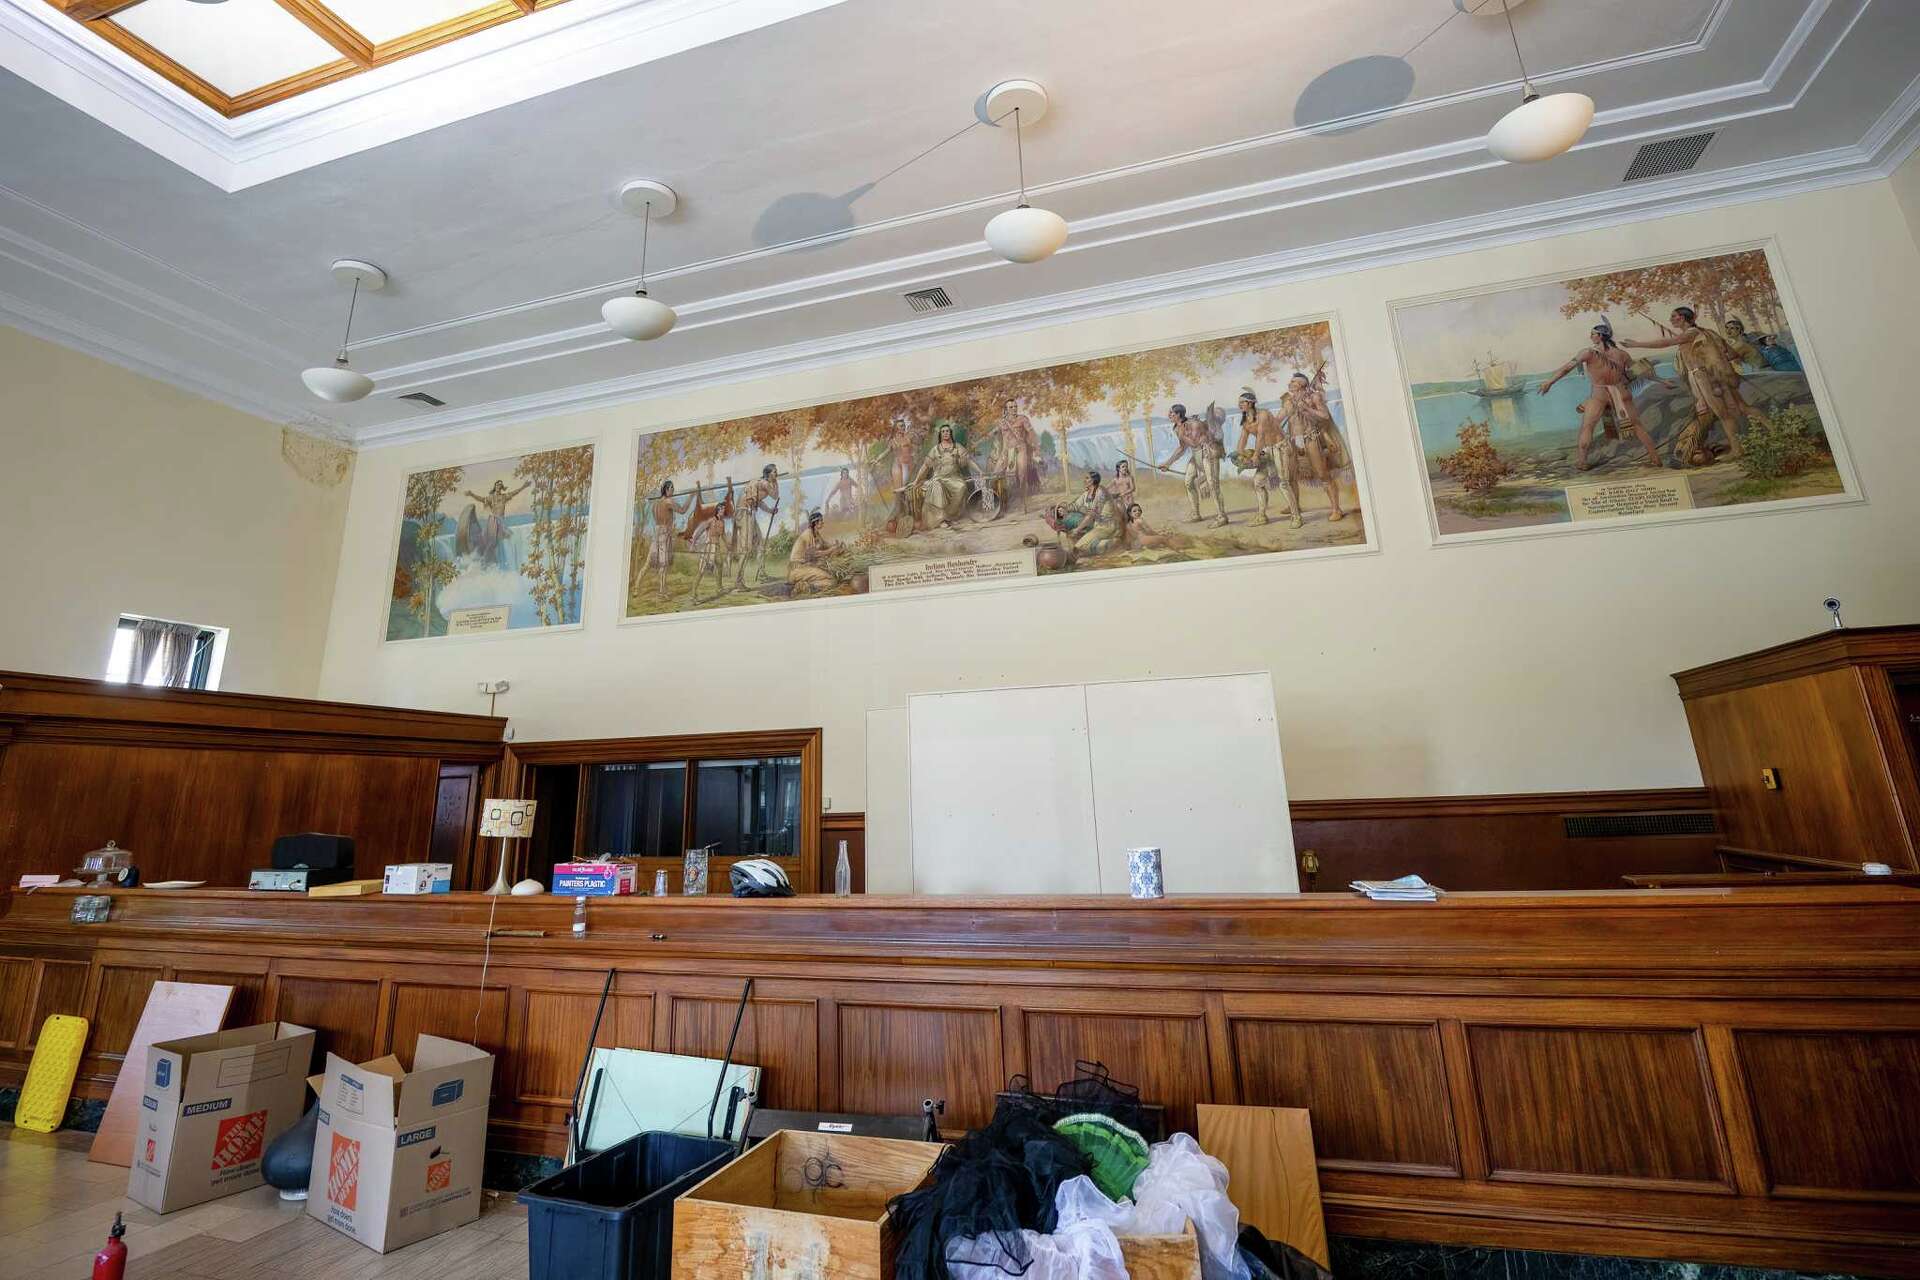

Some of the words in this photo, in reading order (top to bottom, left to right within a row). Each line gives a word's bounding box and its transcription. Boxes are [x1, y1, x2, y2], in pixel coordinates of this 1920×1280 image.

[186, 1100, 229, 1115] MEDIUM
[212, 1112, 265, 1168] HOME
[400, 1128, 433, 1145] LARGE
[329, 1141, 359, 1200] HOME
